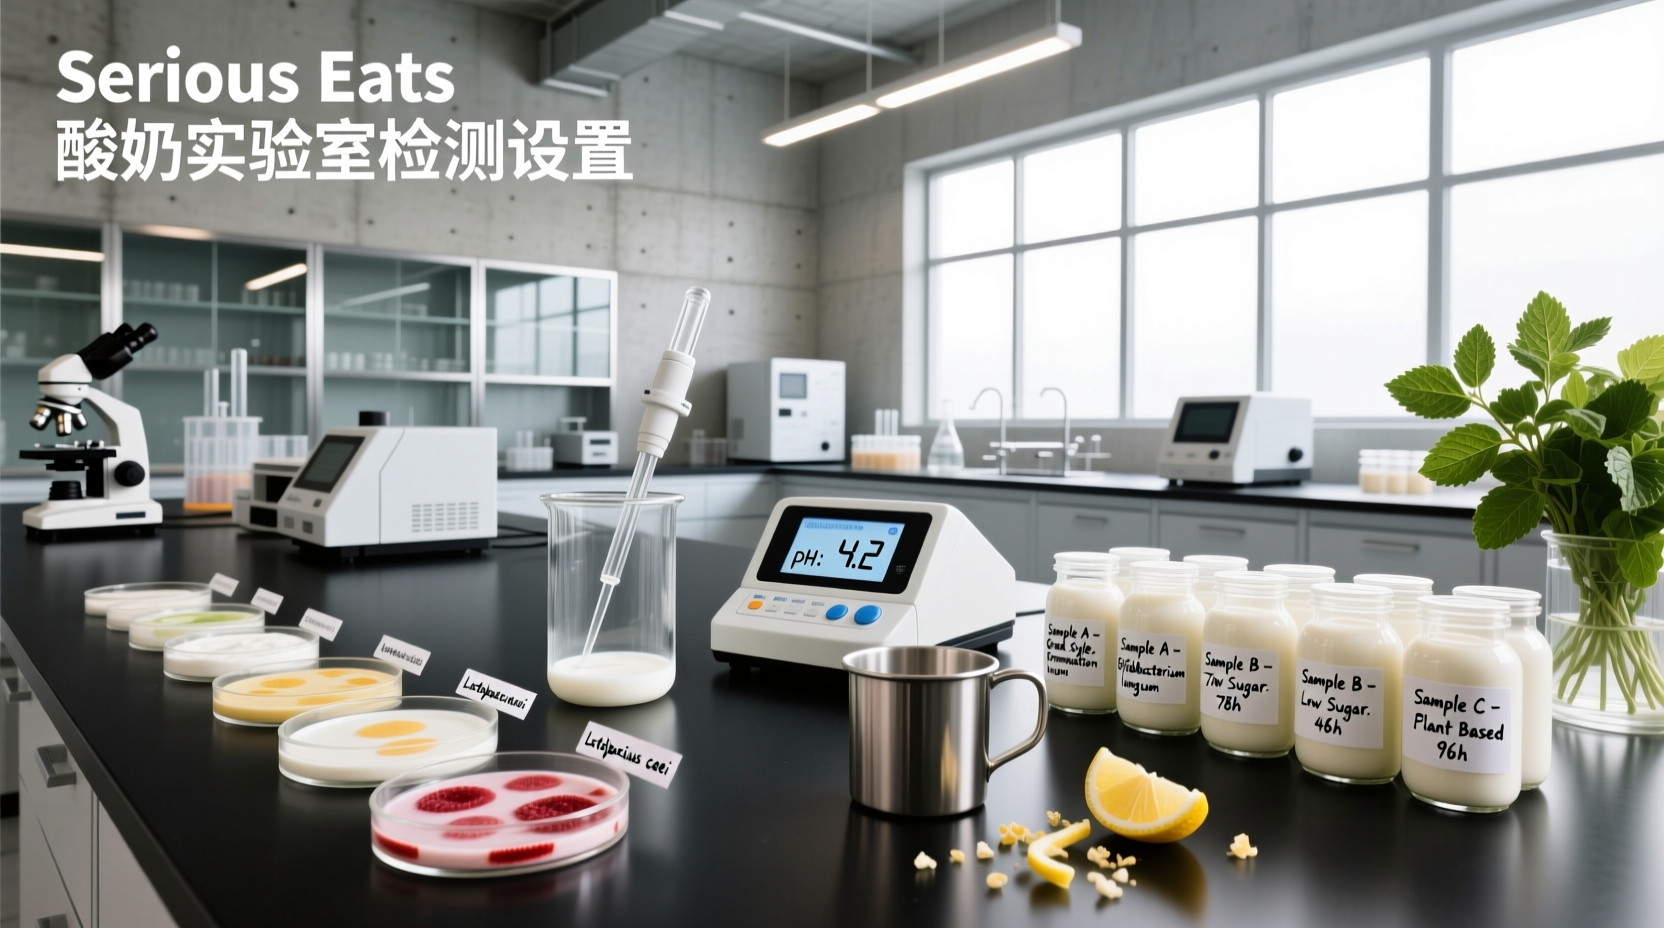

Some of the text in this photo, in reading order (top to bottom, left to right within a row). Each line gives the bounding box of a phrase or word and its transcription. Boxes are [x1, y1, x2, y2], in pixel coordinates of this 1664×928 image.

[790, 539, 885, 571] pH: 4.2
[1080, 626, 1090, 640] A
[1120, 636, 1155, 660] Sample
[1159, 640, 1170, 656] A
[1204, 651, 1244, 676] Sample
[1248, 656, 1260, 673] B
[1301, 668, 1346, 695] Sample
[1351, 675, 1363, 692] B
[1326, 696, 1371, 723] Sugar.
[1414, 688, 1467, 717] Sample
[1473, 697, 1486, 714] C
[1314, 716, 1343, 736] 46h
[1413, 712, 1505, 741] Plant Based
[1436, 740, 1468, 762] 96h
